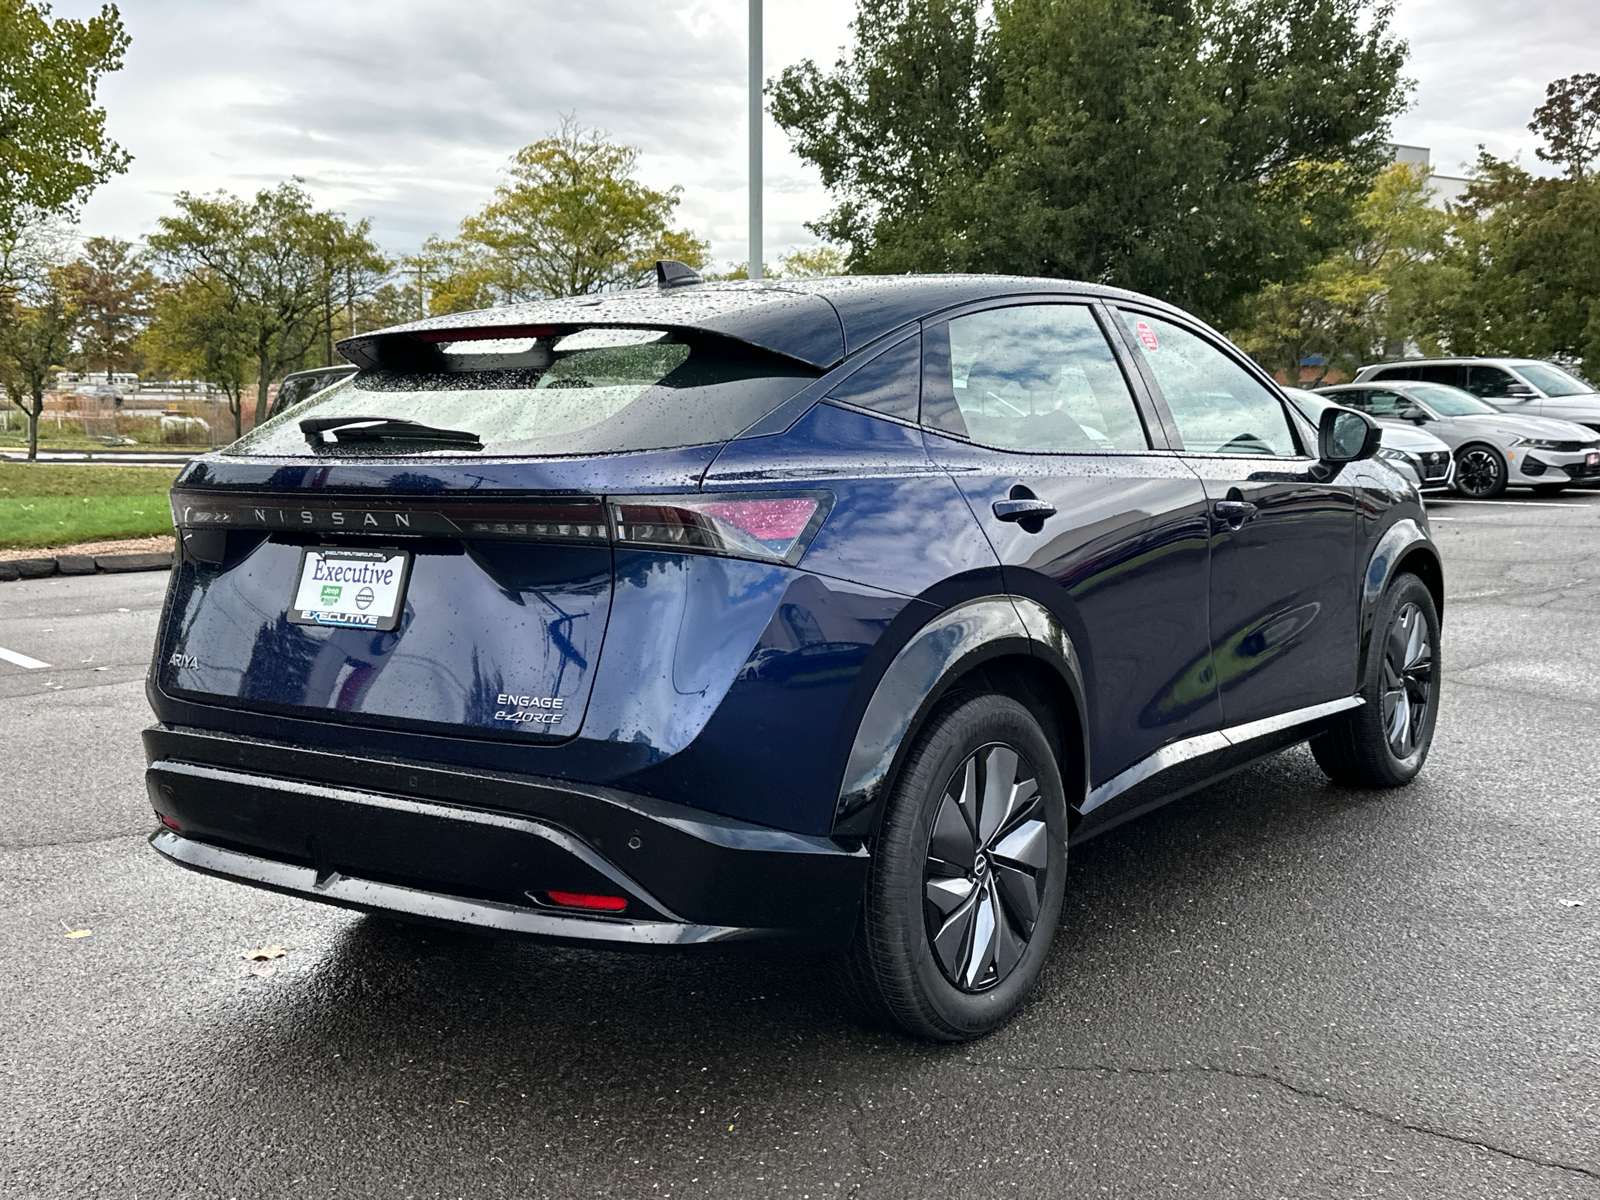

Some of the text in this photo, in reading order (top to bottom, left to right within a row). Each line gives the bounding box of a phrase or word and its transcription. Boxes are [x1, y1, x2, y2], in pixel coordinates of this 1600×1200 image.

[254, 508, 411, 527] NISSAN
[312, 559, 393, 585] Executive
[323, 586, 340, 595] Jeep
[301, 610, 379, 624] EXECUTIVE
[167, 653, 199, 671] ARIYA
[497, 694, 564, 709] ENGAGE
